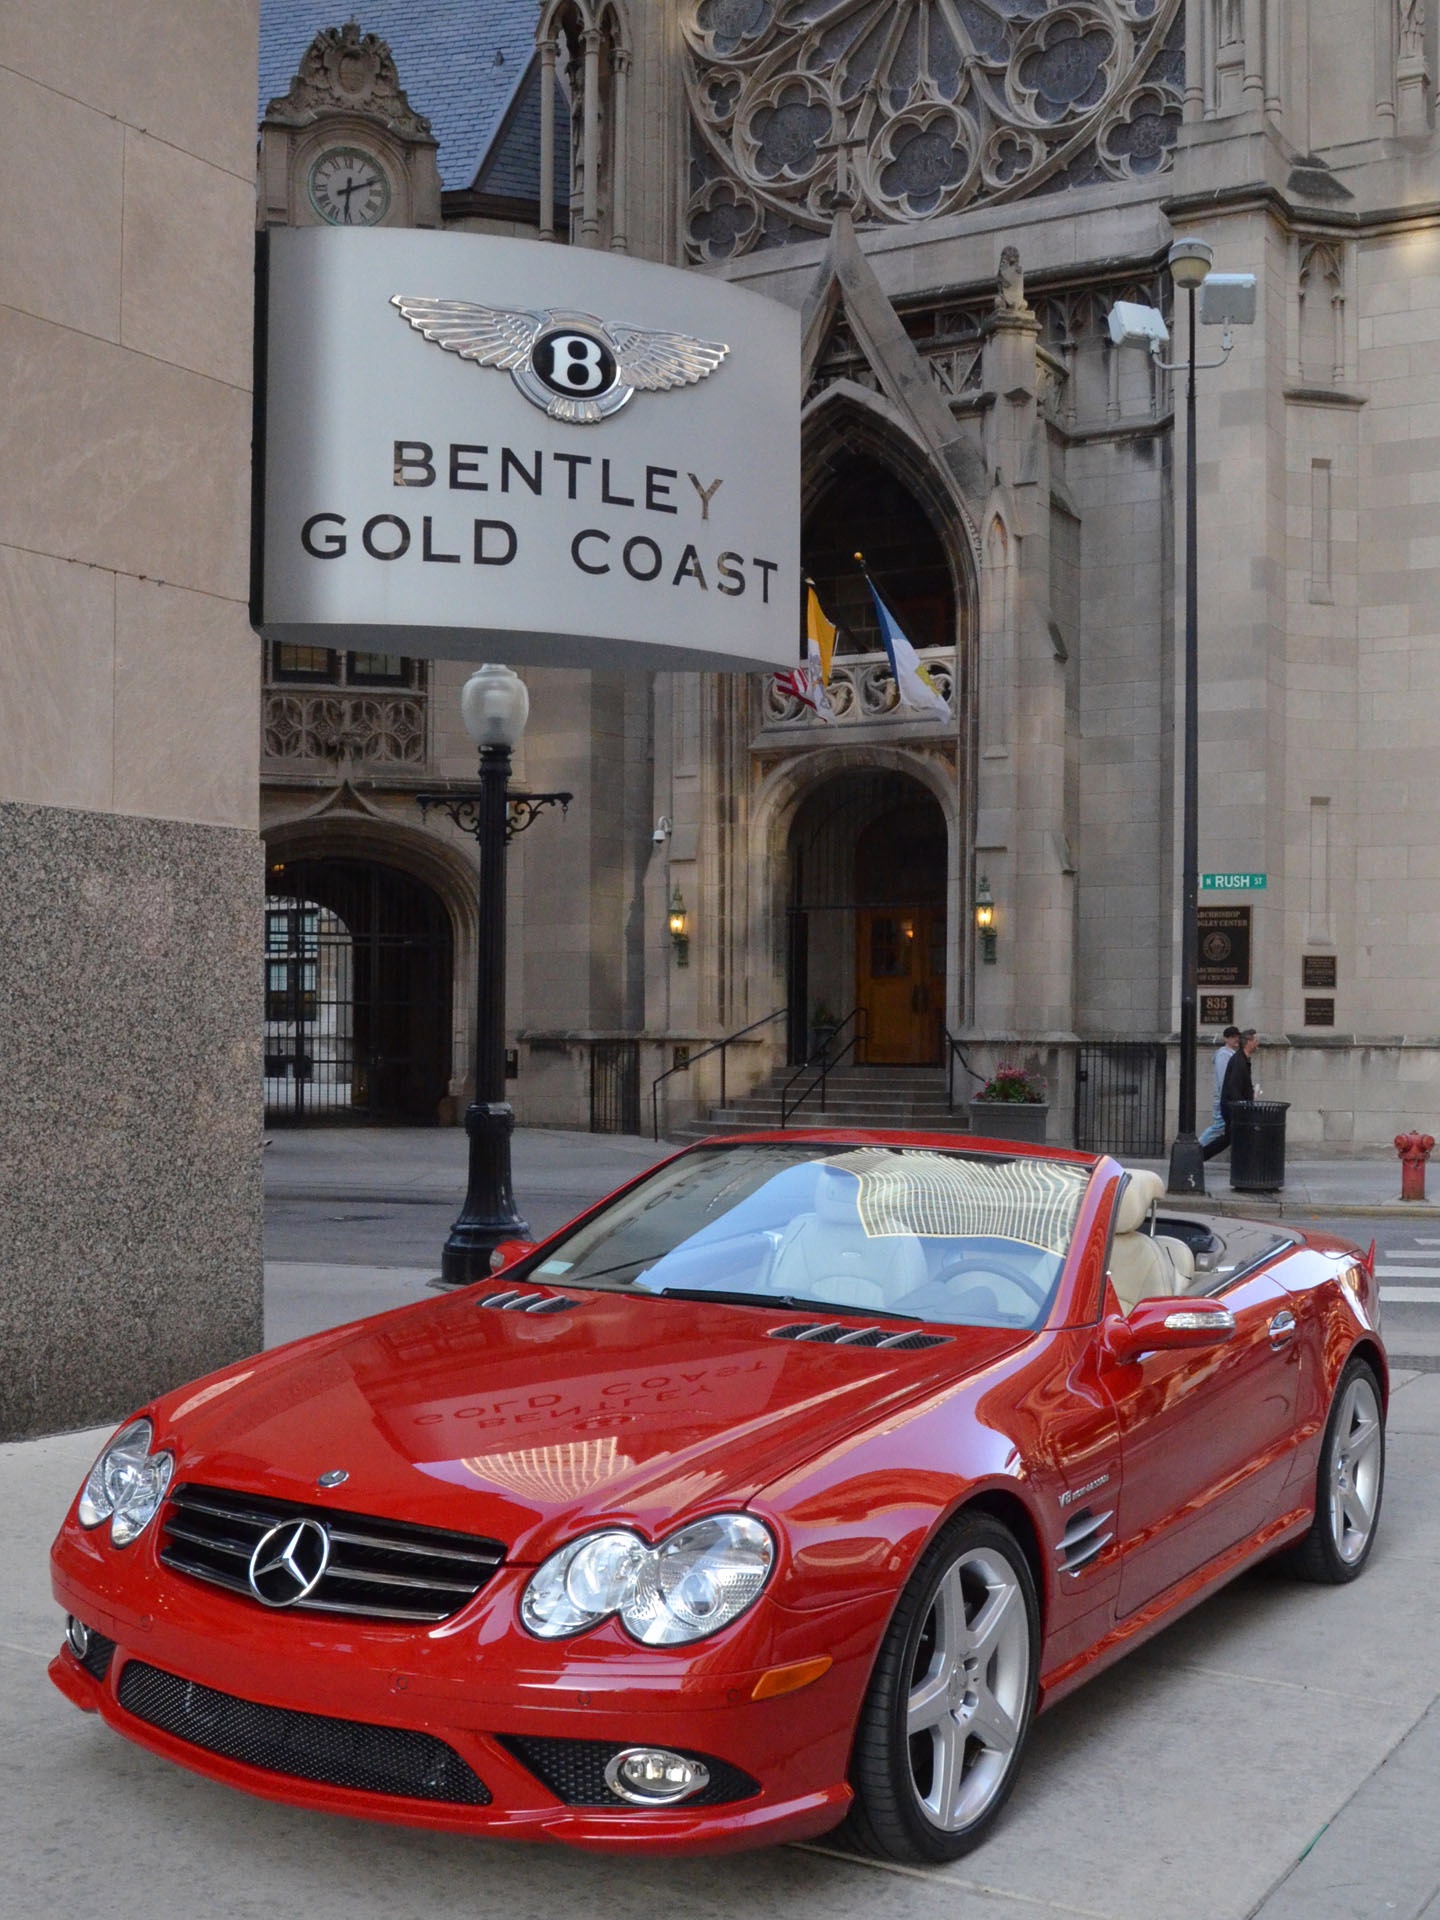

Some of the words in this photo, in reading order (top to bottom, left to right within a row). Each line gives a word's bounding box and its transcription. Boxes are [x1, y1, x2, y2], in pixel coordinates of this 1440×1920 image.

[550, 336, 602, 390] B
[393, 440, 724, 520] BENTLEY
[301, 512, 517, 565] GOLD
[571, 528, 778, 604] COAST
[1206, 878, 1212, 886] N
[1215, 875, 1250, 888] RUSH
[1254, 877, 1263, 885] ST
[1218, 919, 1247, 928] CENTER
[1206, 997, 1227, 1009] 835
